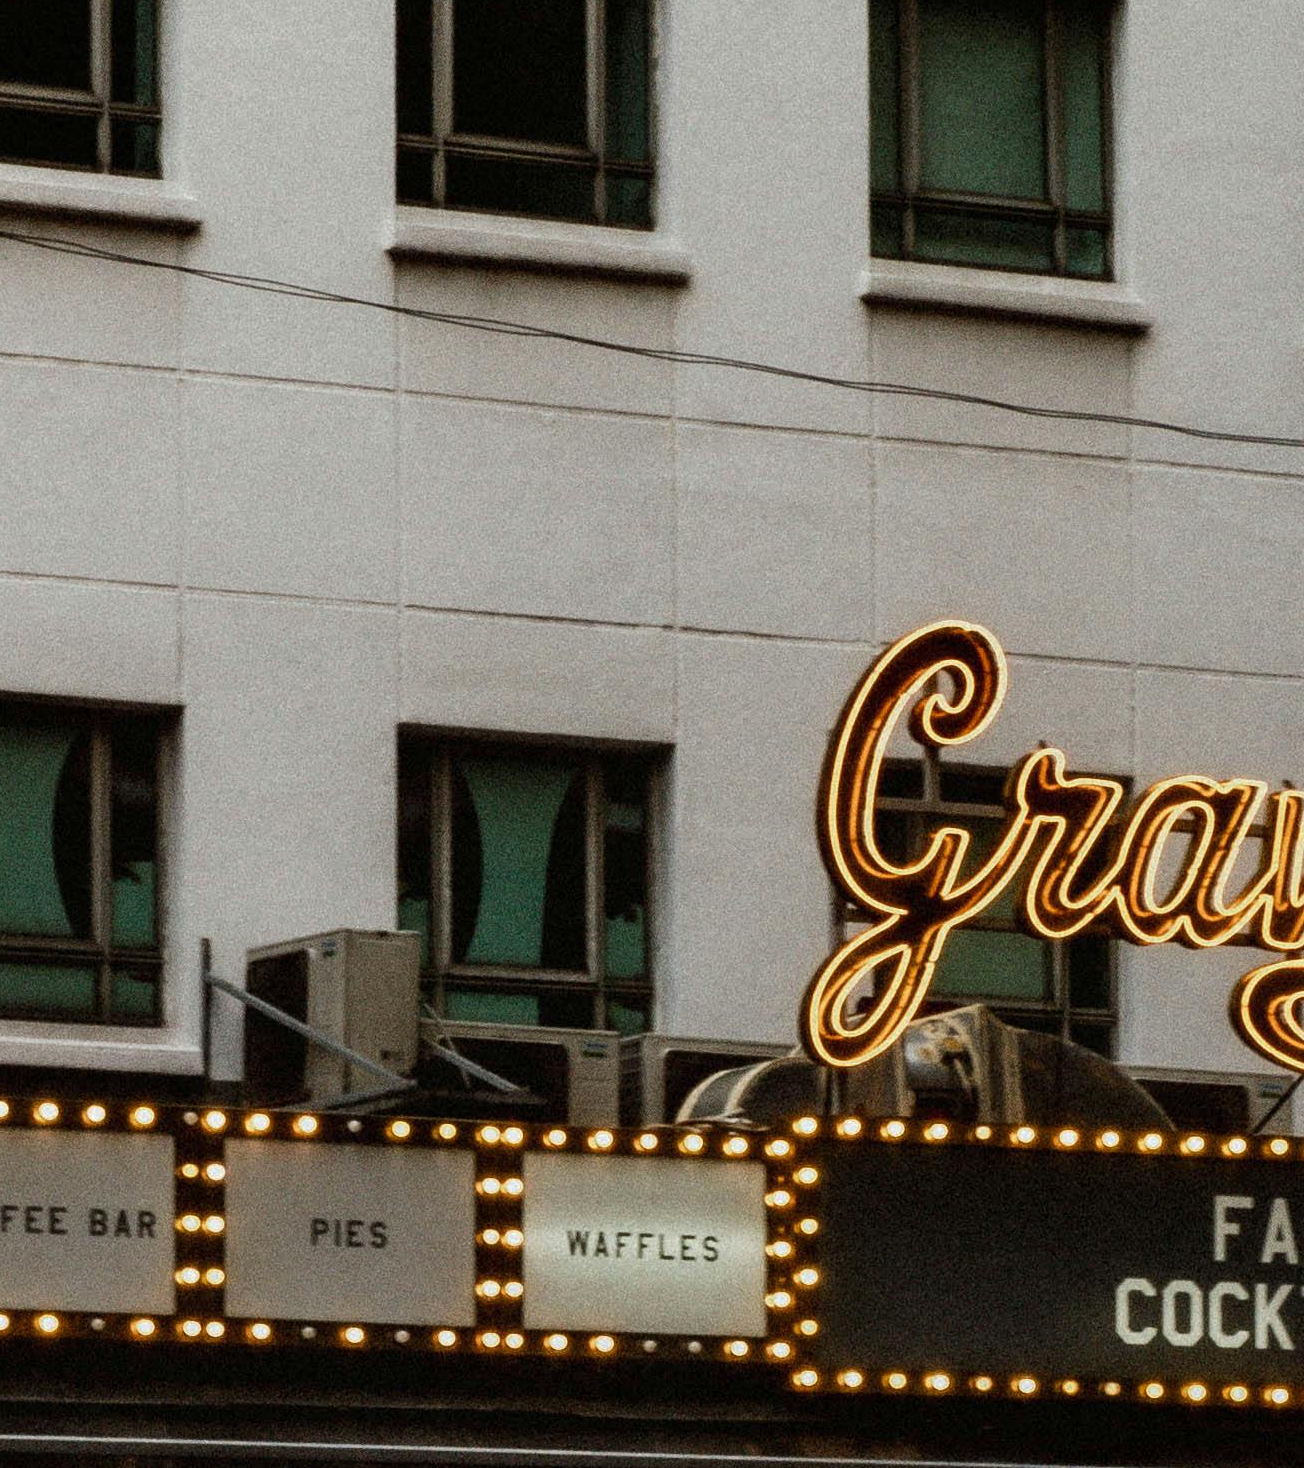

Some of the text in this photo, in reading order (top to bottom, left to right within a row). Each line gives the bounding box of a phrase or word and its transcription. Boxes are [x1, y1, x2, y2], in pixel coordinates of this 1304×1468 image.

[88, 1207, 157, 1238] BAR
[309, 1218, 389, 1249] PIES
[566, 1229, 721, 1262] WAFFLES
